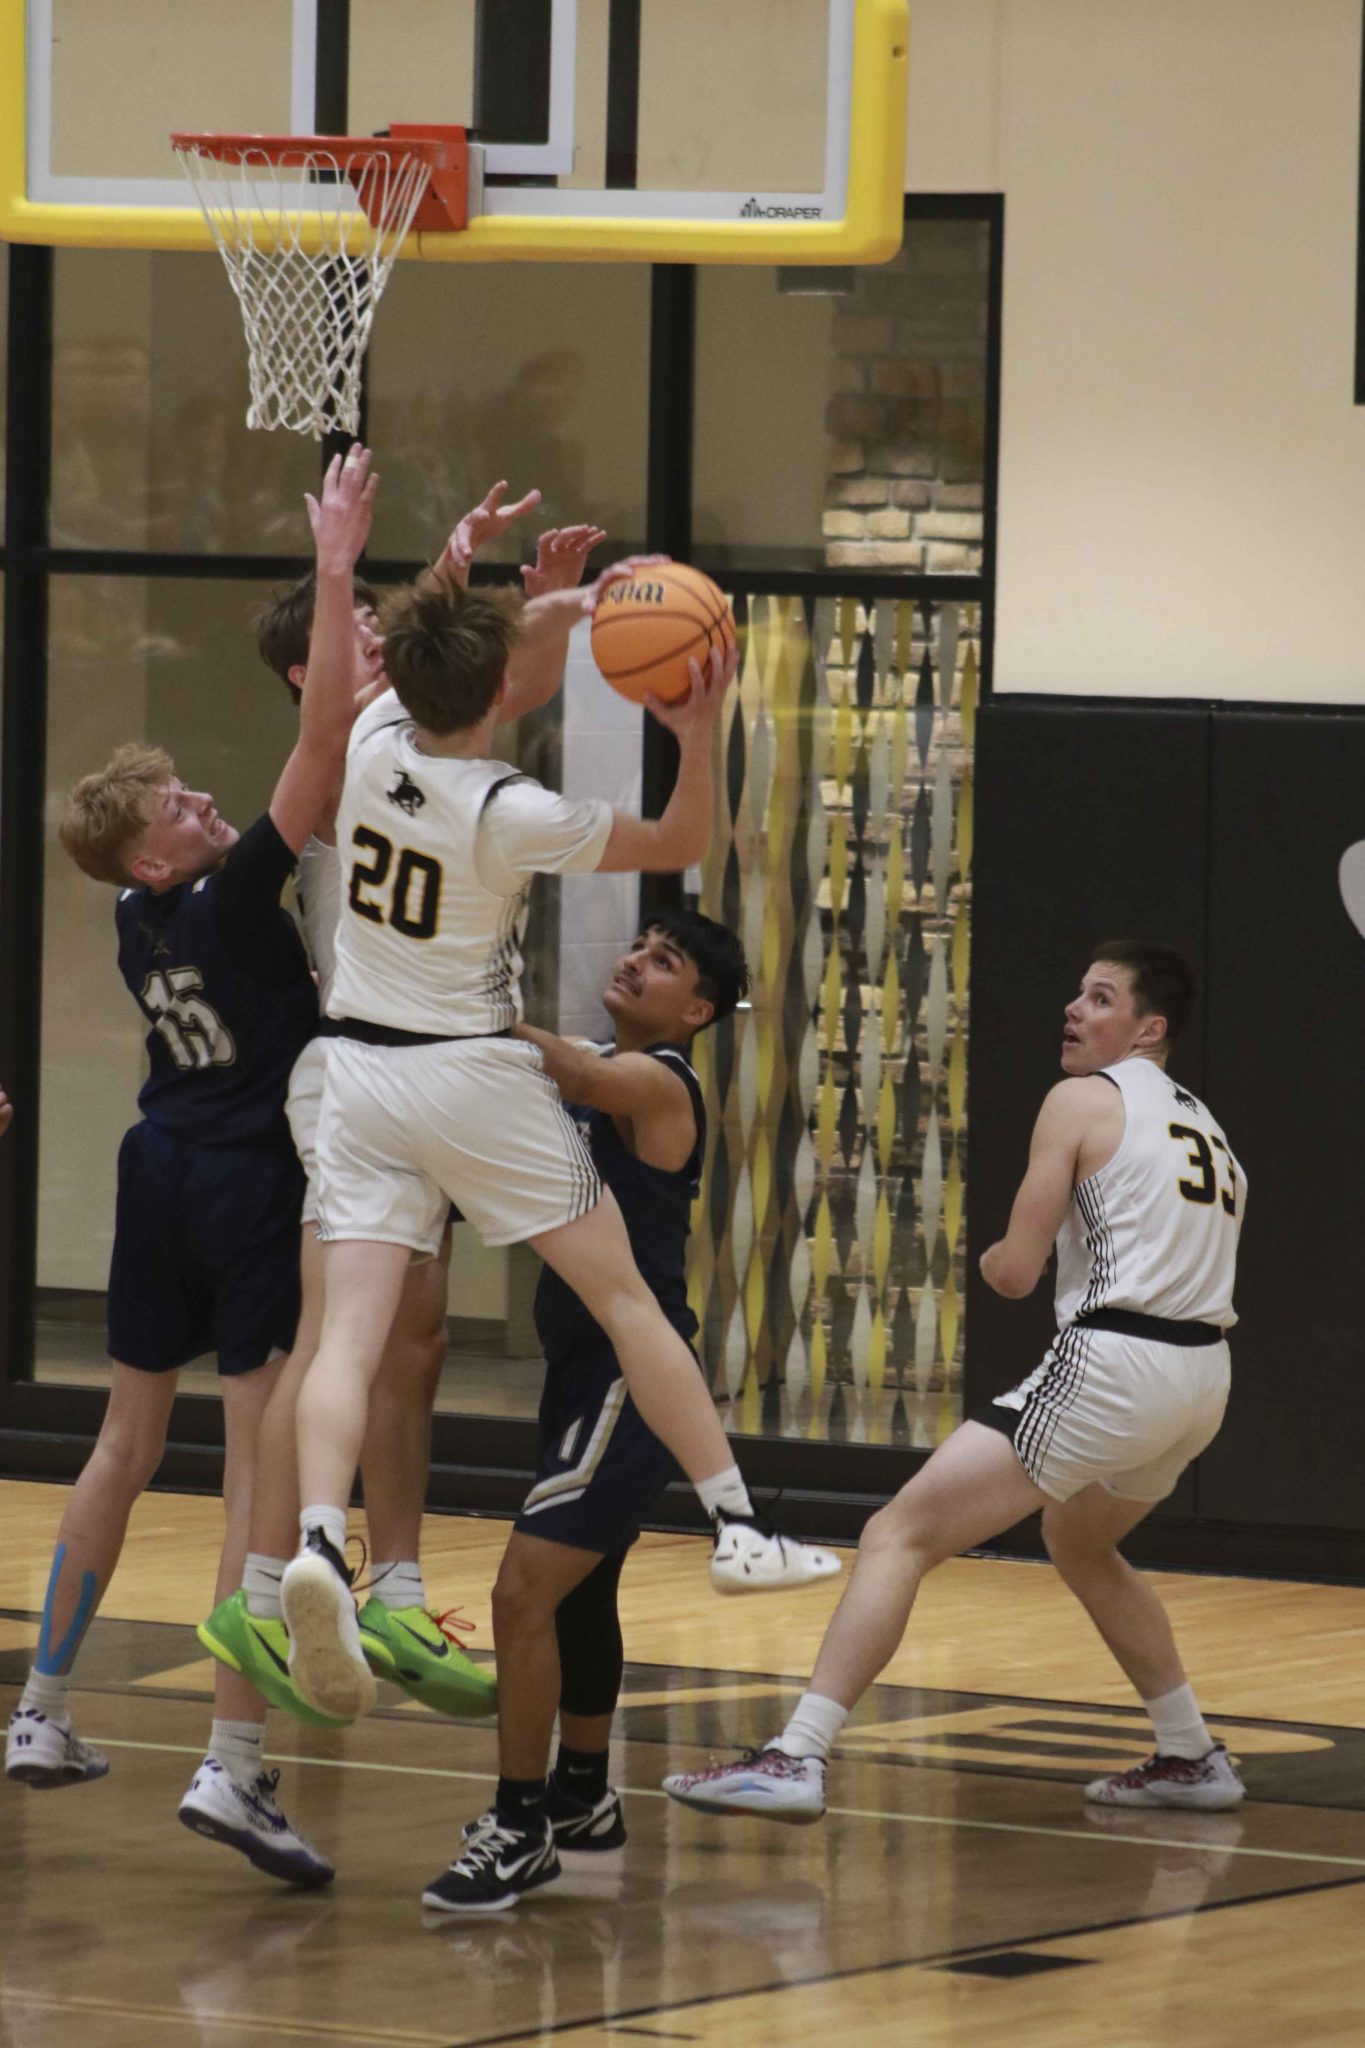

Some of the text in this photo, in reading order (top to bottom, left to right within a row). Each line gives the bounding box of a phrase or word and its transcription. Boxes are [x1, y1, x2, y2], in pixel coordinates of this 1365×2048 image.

[766, 206, 821, 219] DRAPER
[349, 823, 444, 941] 20
[141, 965, 236, 1070] 15
